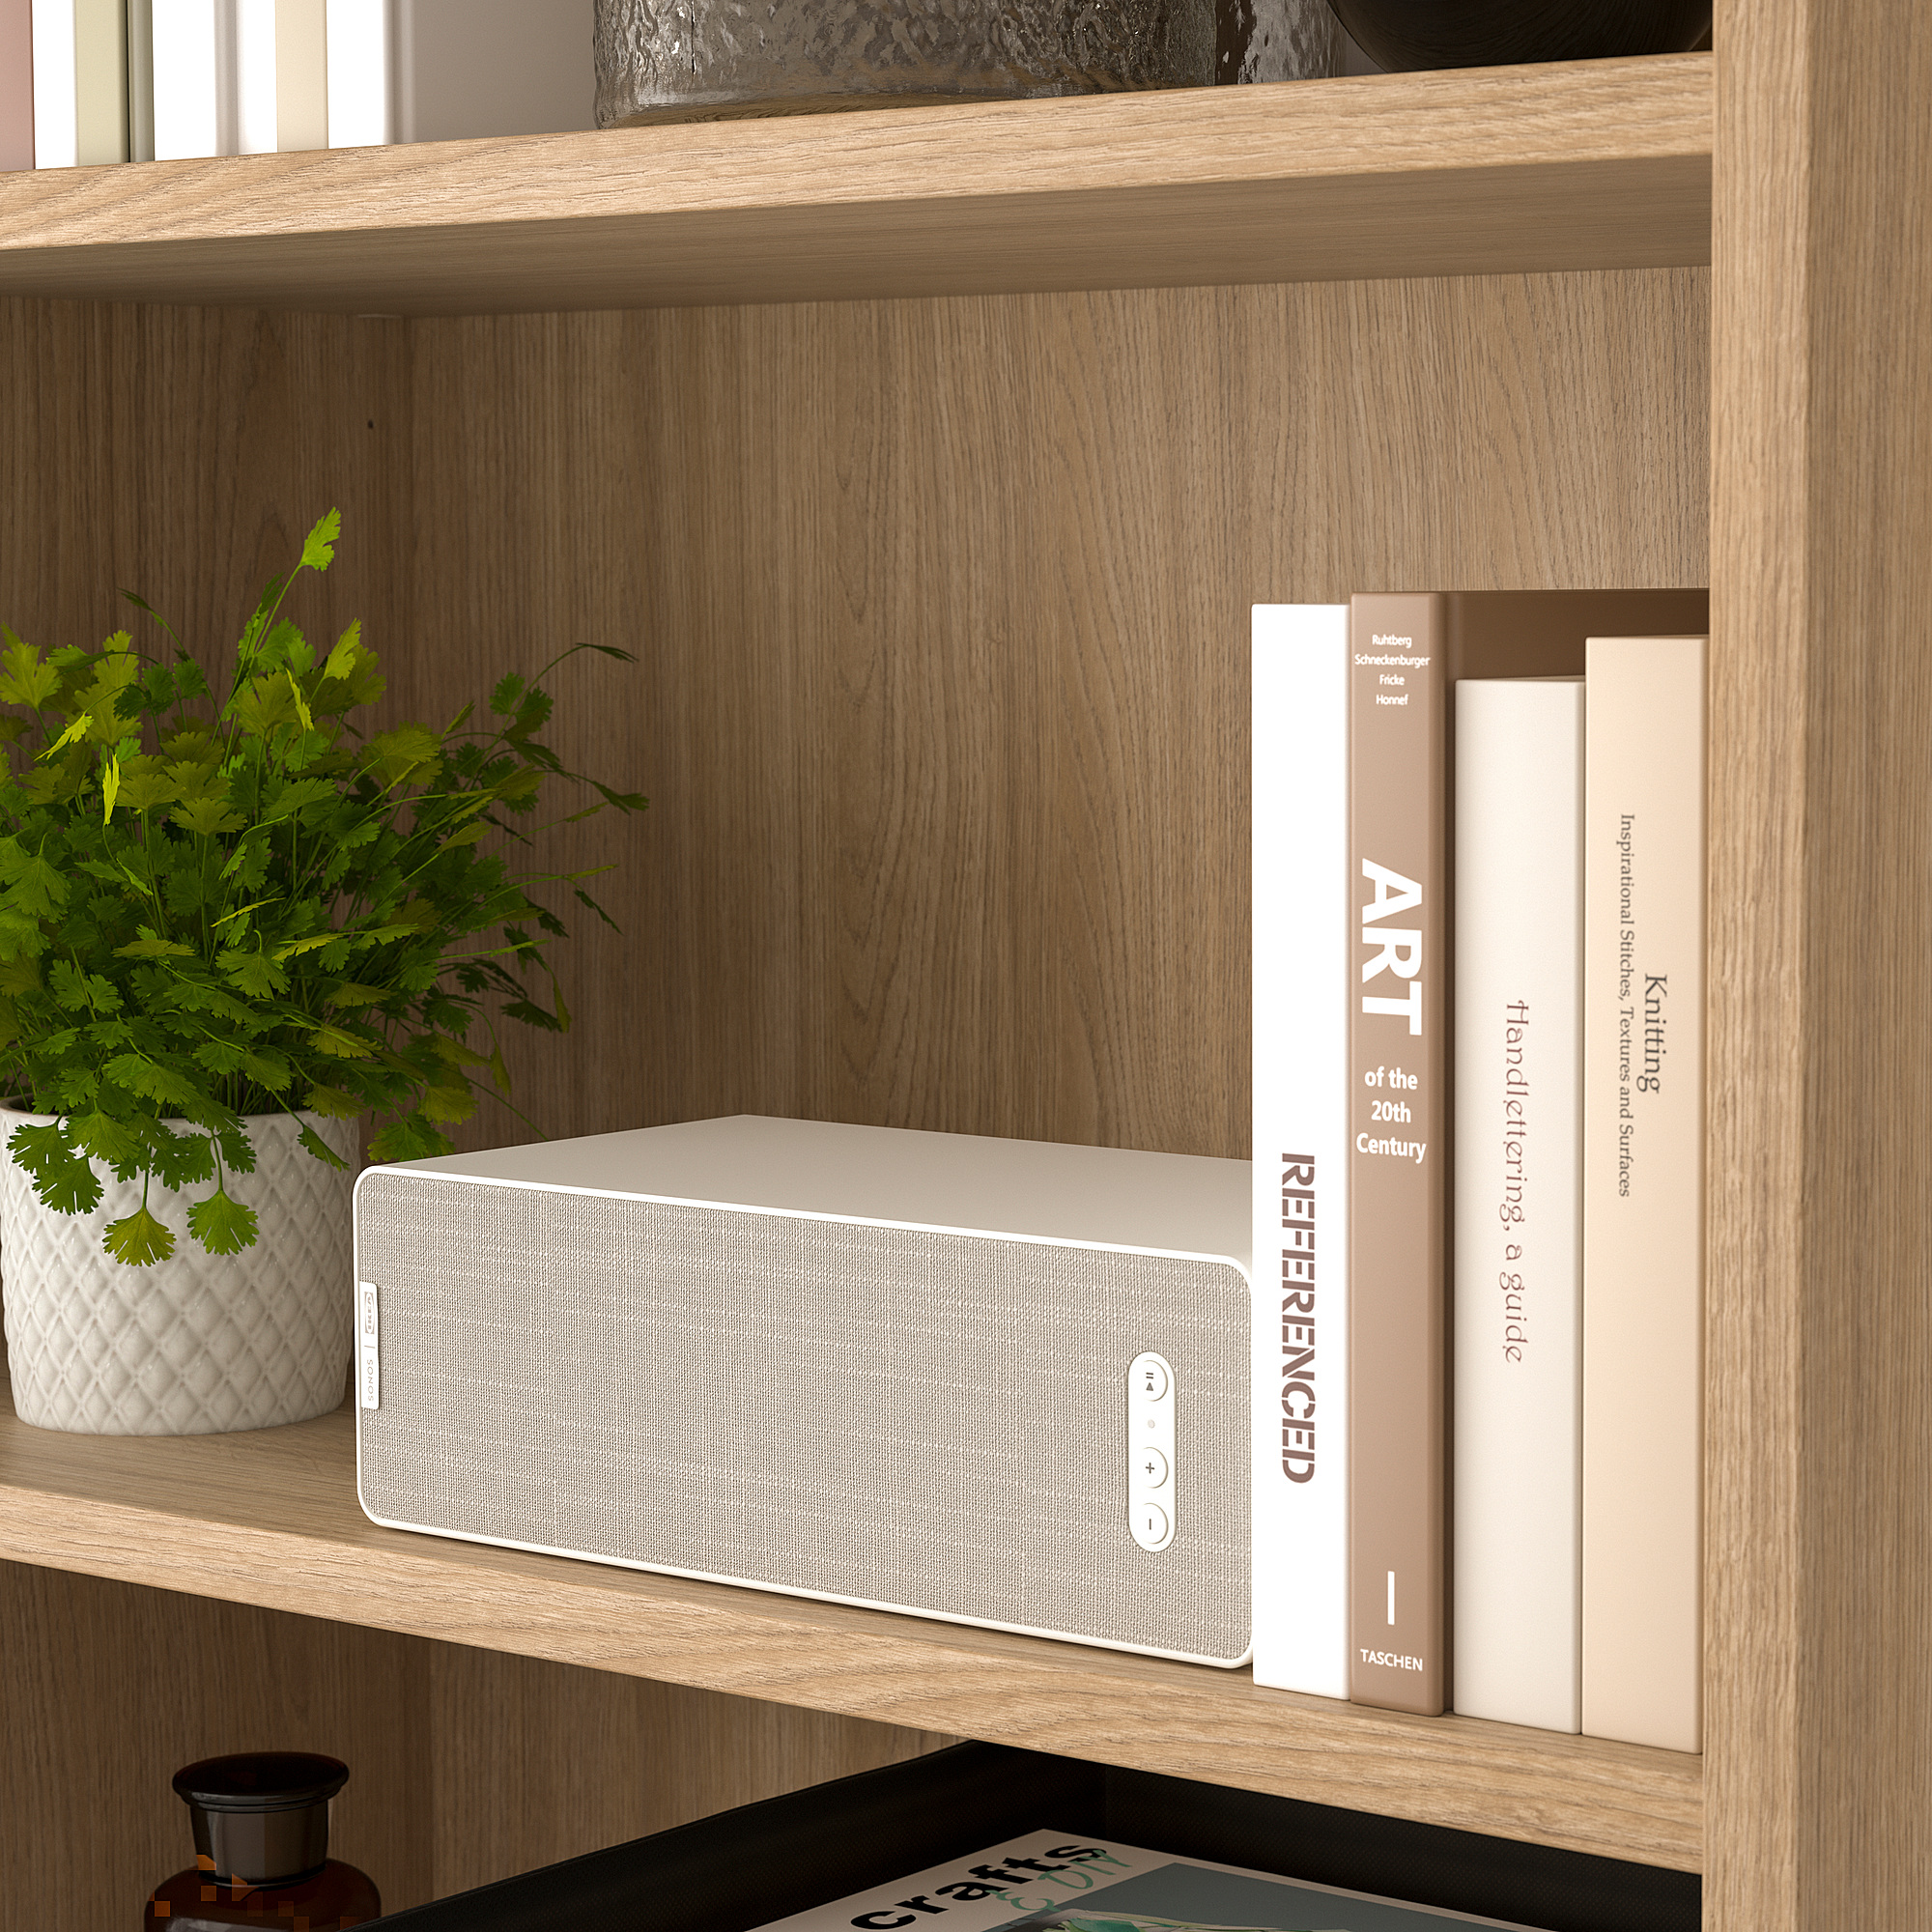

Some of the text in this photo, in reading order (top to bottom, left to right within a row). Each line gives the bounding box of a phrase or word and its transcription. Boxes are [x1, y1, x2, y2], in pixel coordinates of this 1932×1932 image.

[1373, 635, 1411, 648] Ruhtberg
[1354, 654, 1430, 668] Schneckenburger
[1379, 674, 1405, 685] Fricke
[1377, 695, 1408, 705] Honnef
[1362, 859, 1422, 1035] ART
[1616, 814, 1634, 1197] Inspirational Stitches, Textures and Surfaces
[1636, 974, 1667, 1094] Knitting
[1365, 1066, 1417, 1090] of the
[1372, 1100, 1410, 1122] 20th
[1356, 1133, 1426, 1163] Century
[1499, 1000, 1529, 1362] Handlettering, a guide
[365, 1293, 374, 1332] IKEA
[1282, 1153, 1316, 1483] REFERENCED
[1360, 1649, 1422, 1671] TASCHEN
[852, 1845, 1108, 1928] crafts
